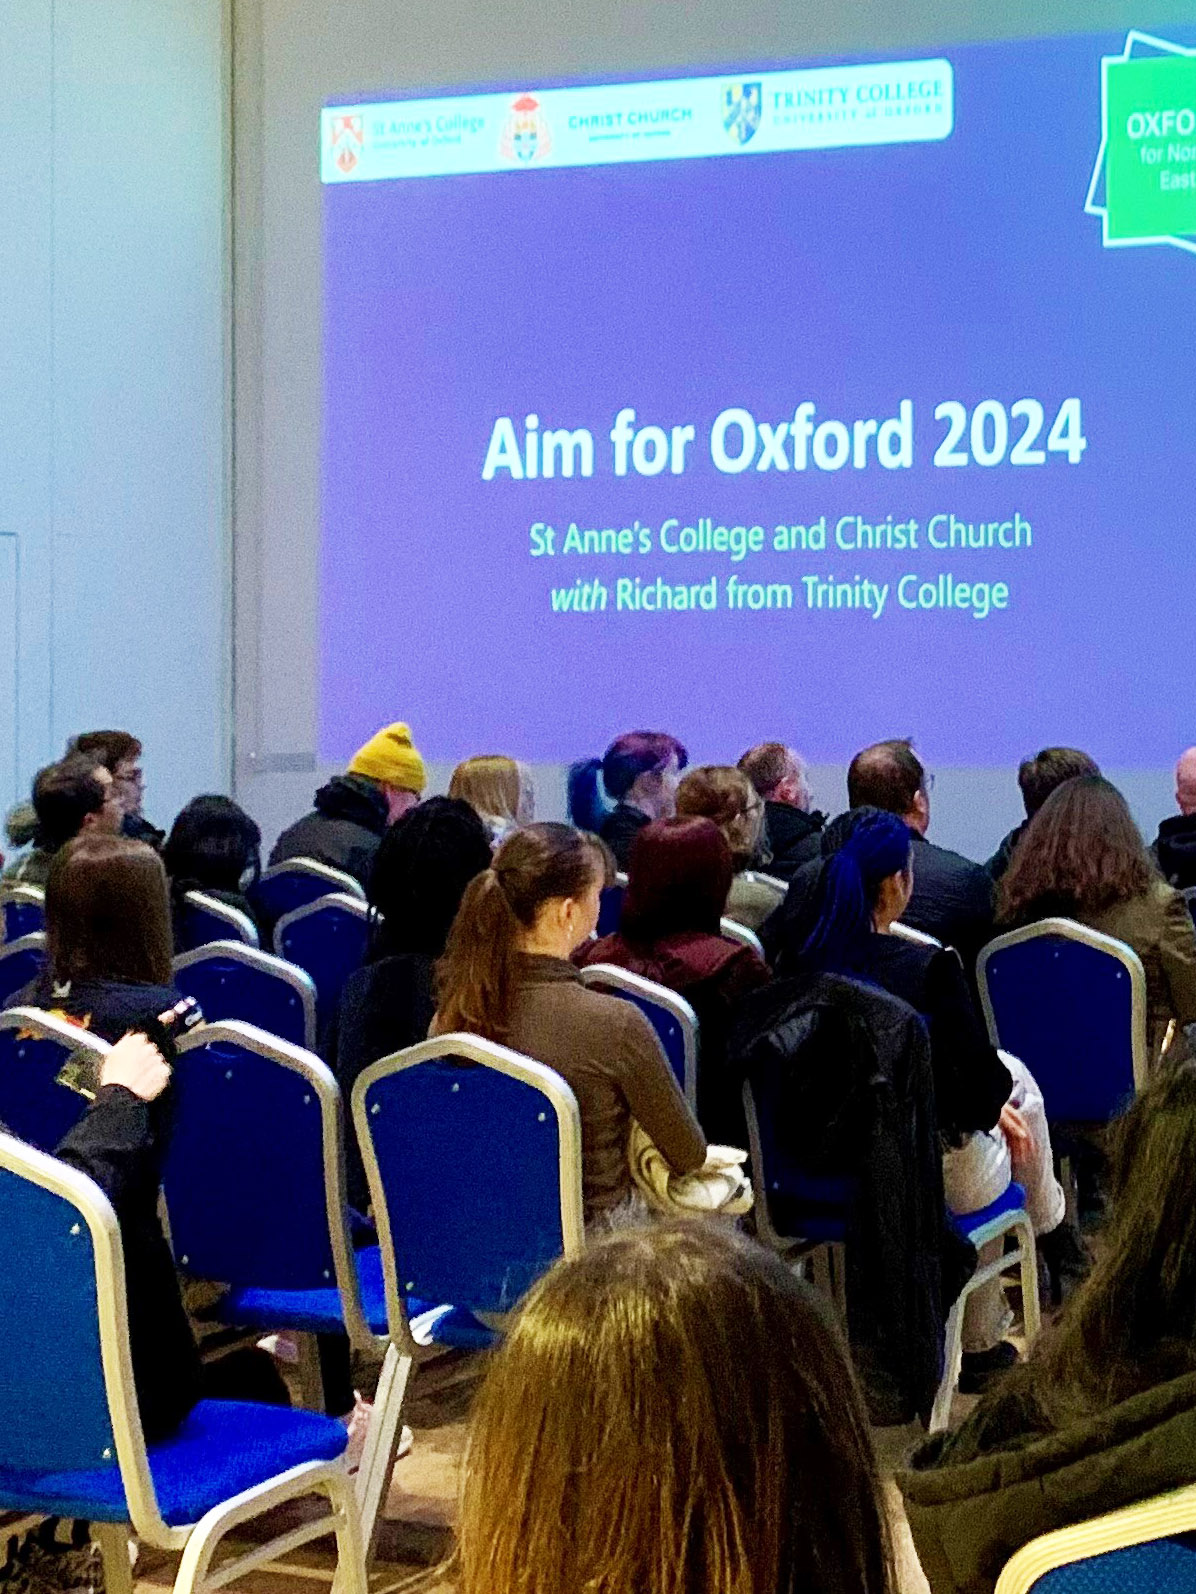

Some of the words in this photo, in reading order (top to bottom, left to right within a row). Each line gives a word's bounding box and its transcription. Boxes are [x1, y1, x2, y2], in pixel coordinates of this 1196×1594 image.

[772, 87, 848, 110] TRINITY
[856, 80, 944, 102] COLLEGE
[436, 112, 485, 136] College
[567, 112, 623, 129] CHRIST
[627, 107, 693, 125] CHURCH
[1140, 145, 1164, 164] for
[1159, 170, 1196, 190] East
[481, 412, 594, 481] Aim
[610, 407, 695, 477] for
[710, 398, 914, 475] Oxford
[933, 397, 1087, 468] 2024
[529, 521, 555, 556] St
[562, 520, 652, 555] Anne's
[660, 517, 764, 562] College
[772, 515, 826, 551] and
[835, 515, 919, 550] Christ
[927, 512, 1032, 549] Church
[551, 577, 608, 613] with
[616, 576, 717, 611] Richard
[726, 574, 793, 610] from
[801, 574, 889, 619] Trinity
[897, 572, 1009, 619] College
